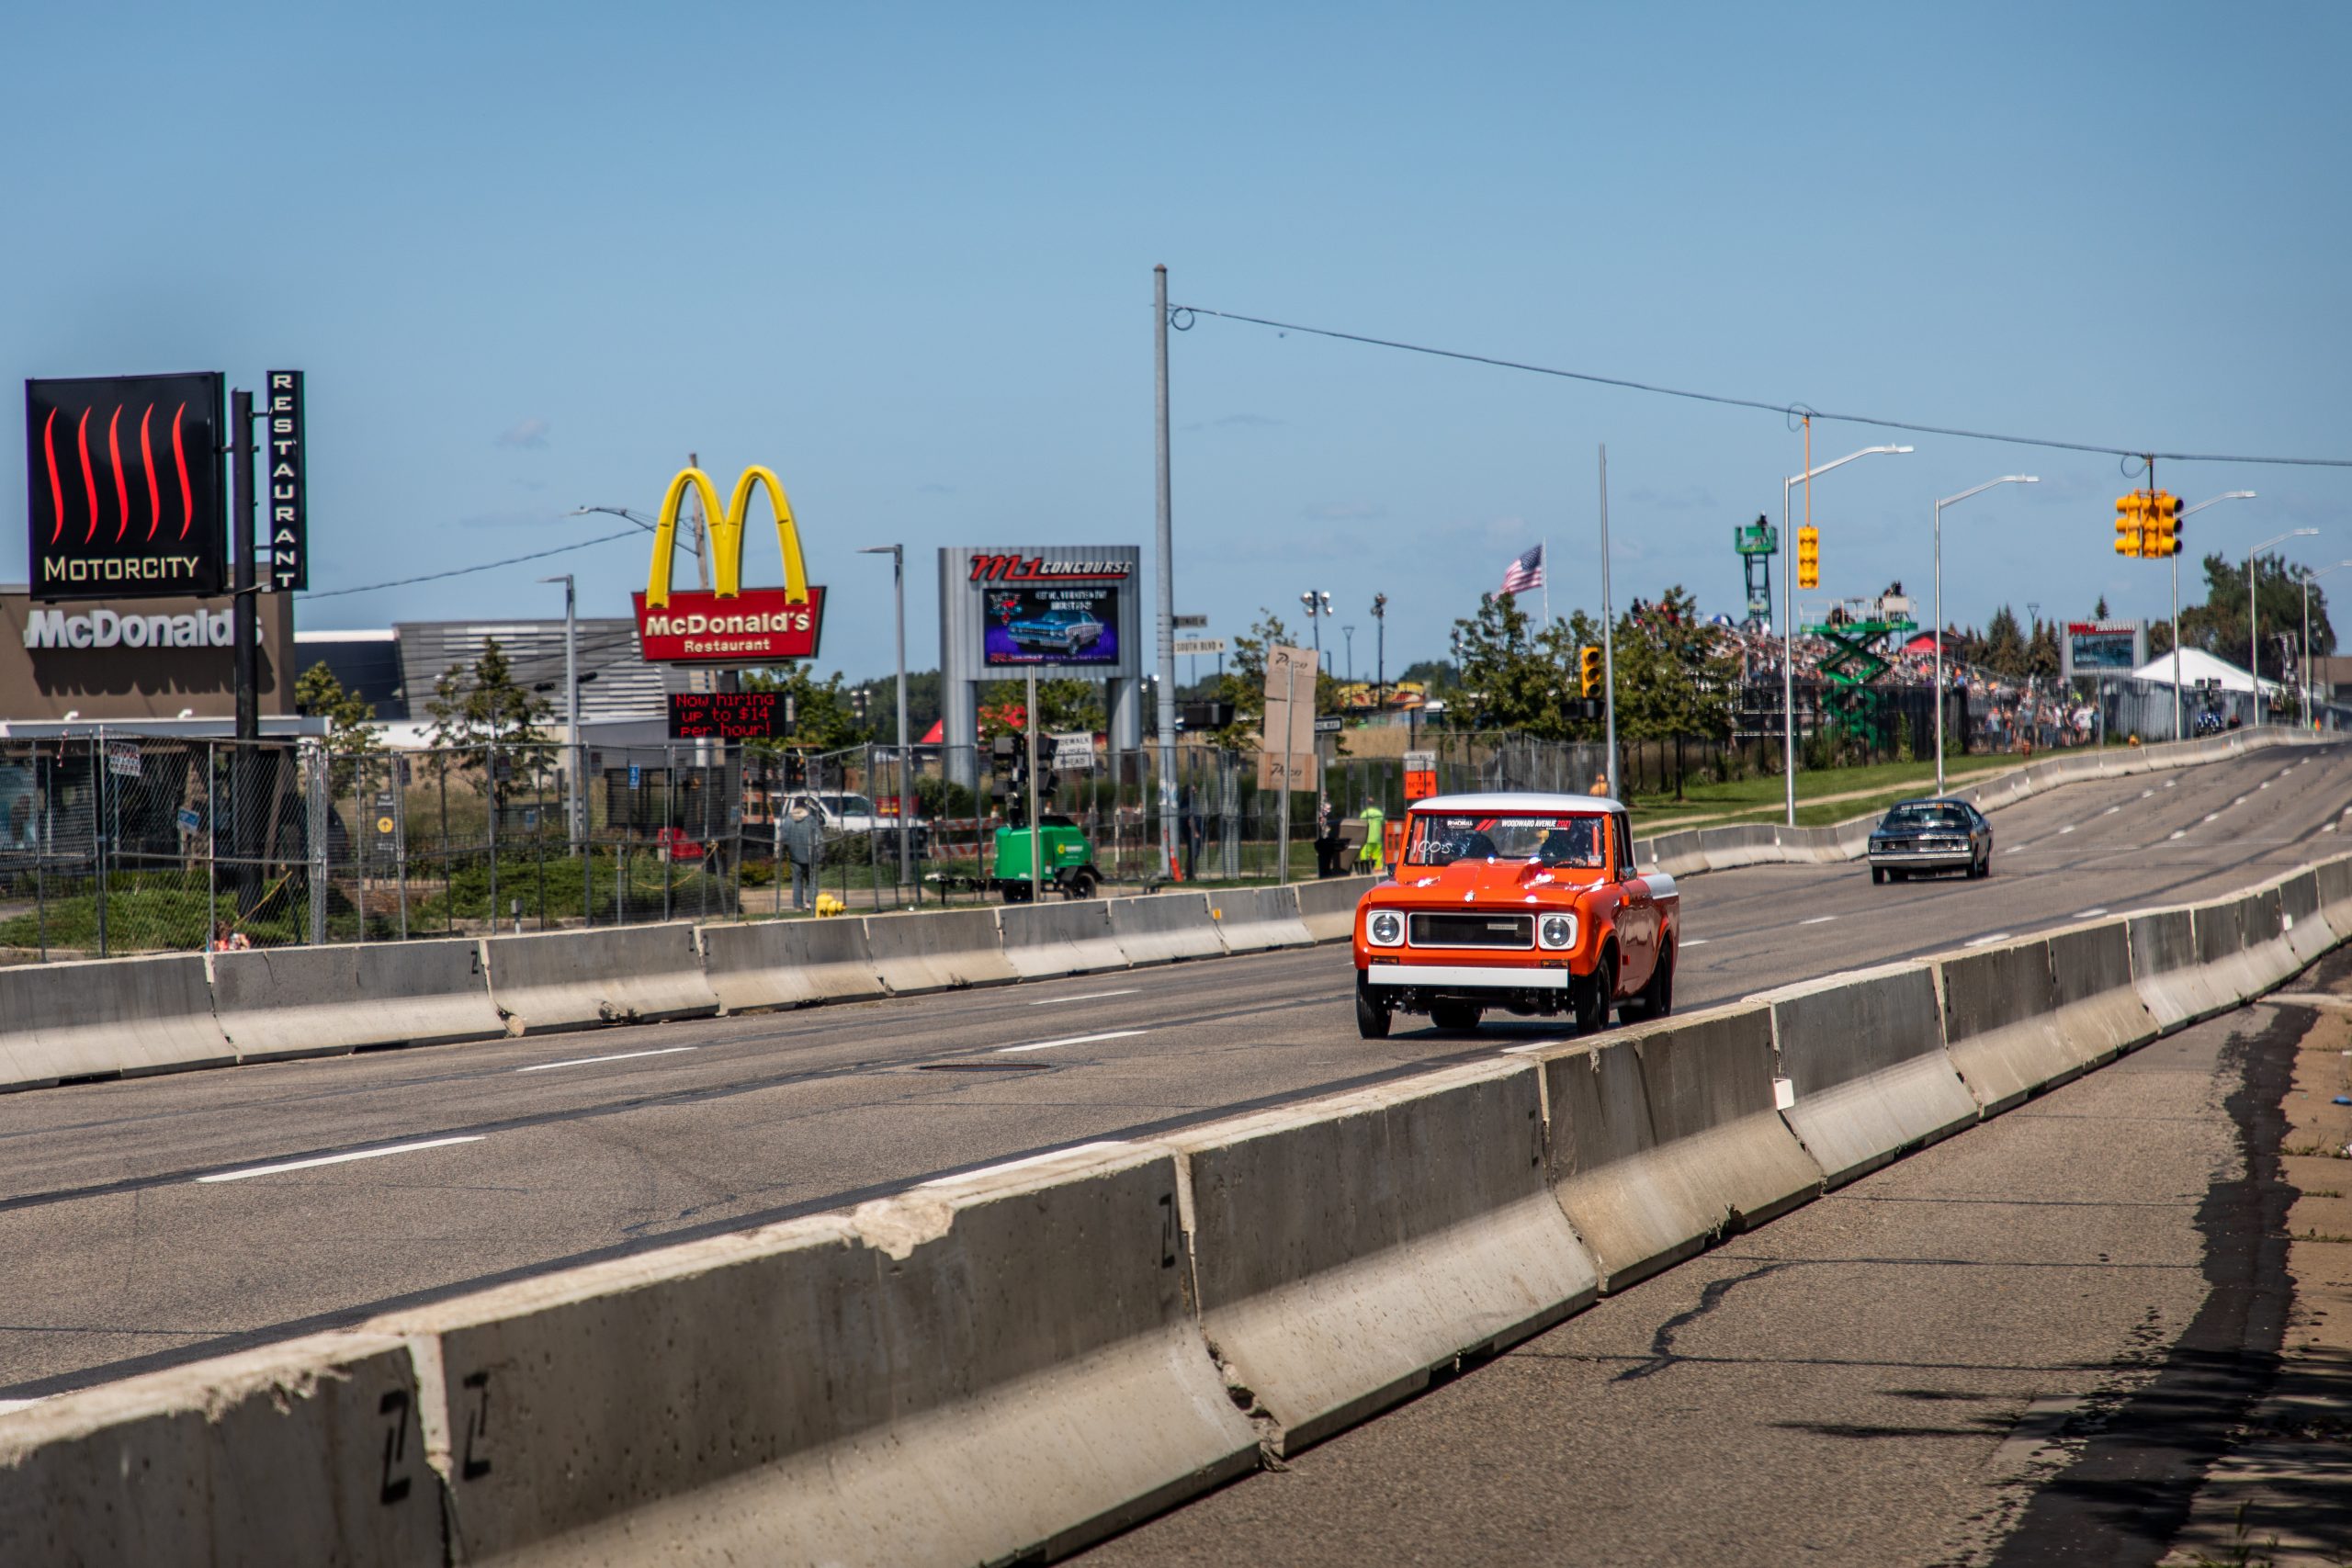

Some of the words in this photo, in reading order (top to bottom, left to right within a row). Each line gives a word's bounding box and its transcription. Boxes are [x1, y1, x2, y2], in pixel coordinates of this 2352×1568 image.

[272, 373, 296, 588] RESTAURANT
[1040, 561, 1133, 574] CONCOURSE
[645, 612, 811, 637] McDonald's
[684, 638, 772, 653] Restaurant
[1176, 641, 1198, 652] SOUTH
[1200, 640, 1216, 651] BLVD
[716, 693, 775, 707] hiring
[711, 707, 732, 722] to
[739, 705, 769, 721] $14
[680, 725, 714, 739] per
[720, 720, 772, 737] hour!
[1058, 737, 1090, 746] DEWALK
[1501, 819, 1534, 828] WOODWARD
[1534, 819, 1556, 828] AVENUE
[1555, 819, 1572, 828] 2021
